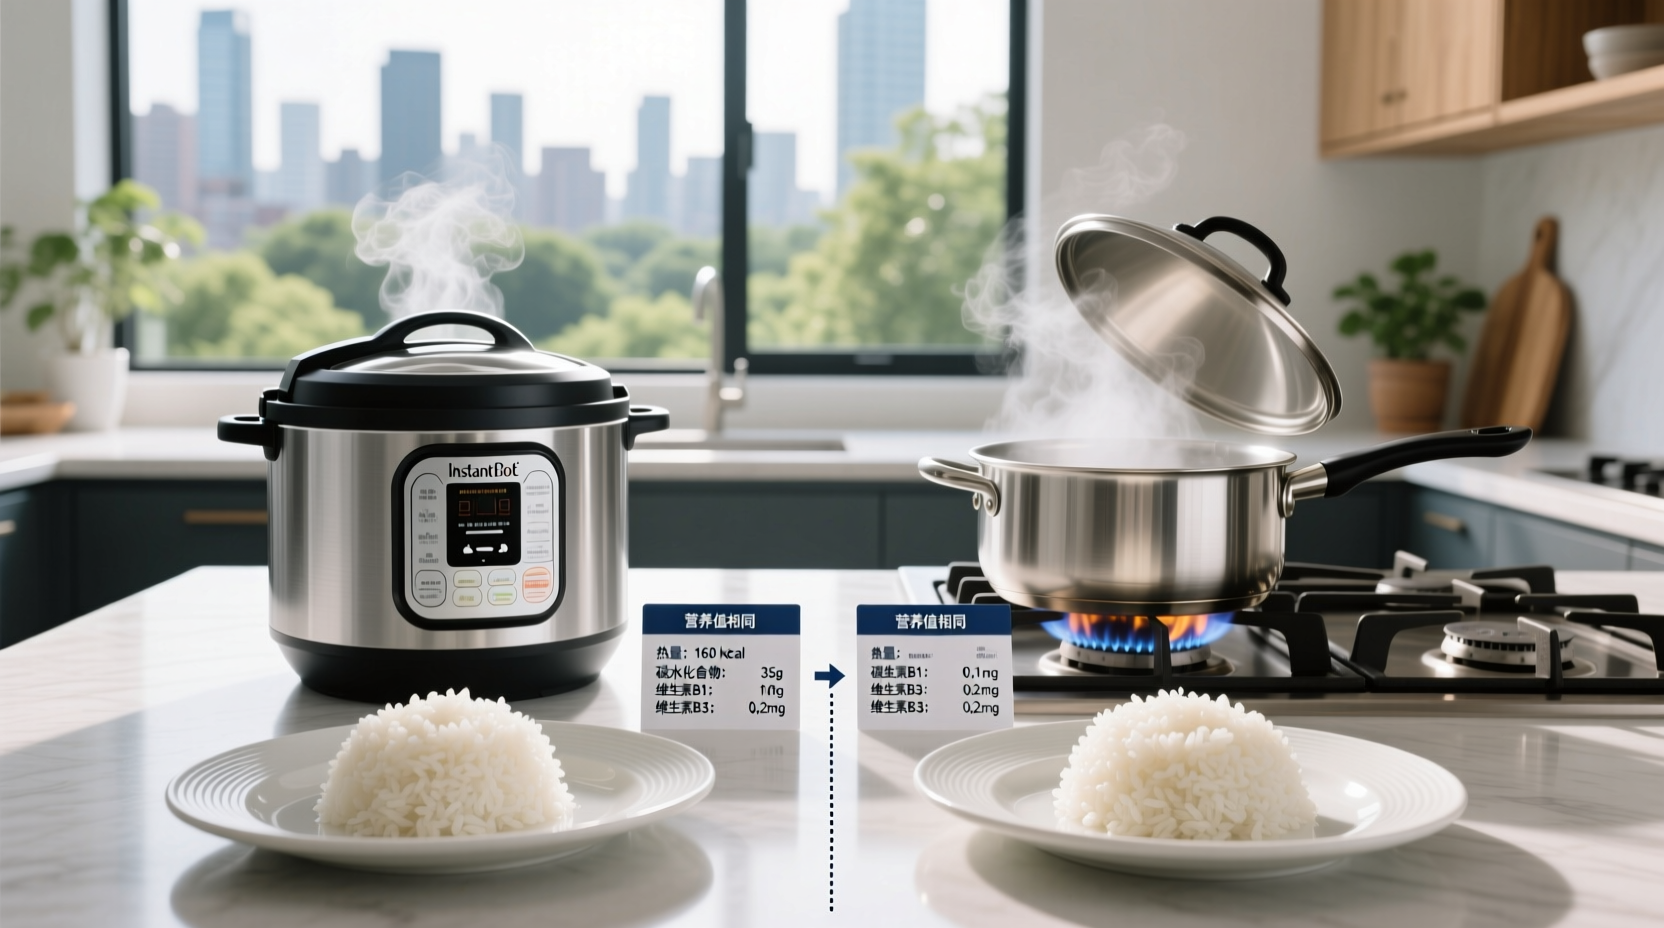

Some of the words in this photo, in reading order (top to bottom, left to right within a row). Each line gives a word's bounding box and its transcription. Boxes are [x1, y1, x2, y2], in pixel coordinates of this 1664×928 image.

[685, 613, 755, 629] 营养值相同
[695, 647, 716, 659] 160
[761, 667, 783, 680] 35g
